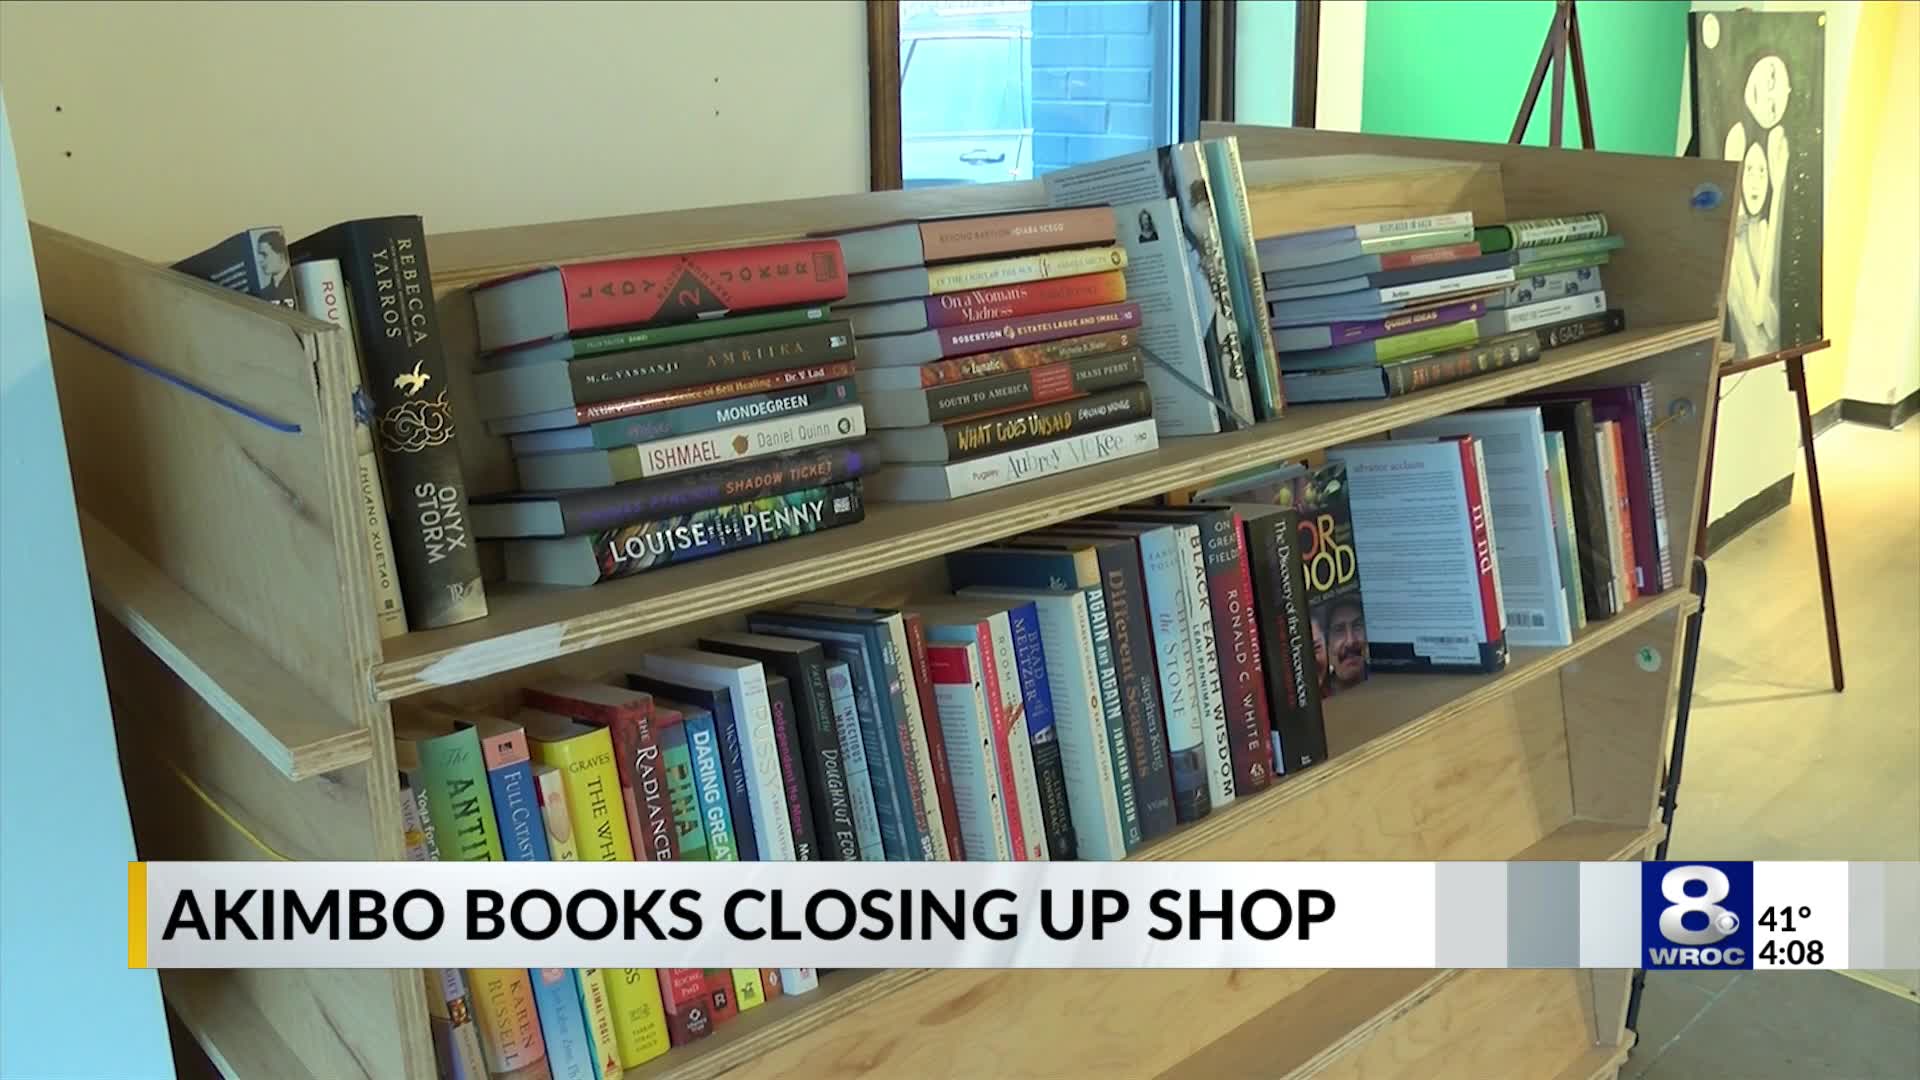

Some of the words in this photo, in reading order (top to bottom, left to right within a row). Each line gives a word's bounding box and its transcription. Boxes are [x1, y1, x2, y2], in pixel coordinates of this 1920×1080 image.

[373, 249, 401, 339] YARROS
[397, 238, 427, 344] REBECCA
[579, 279, 657, 300] LADY
[679, 287, 700, 306] 2
[720, 263, 809, 282] JOKER
[940, 294, 963, 310] On
[964, 296, 973, 307] a
[952, 330, 1004, 345] ROBERTSON
[1016, 323, 1053, 336] ESTATES
[1054, 319, 1079, 331] LARGE
[1080, 316, 1096, 326] AND
[1096, 313, 1120, 324] SMALL
[961, 305, 1014, 322] Madness
[1559, 323, 1585, 342] GAZA
[616, 361, 680, 379] VASSANJI
[807, 367, 824, 378] Lad
[716, 394, 809, 423] MONDEGREEN
[938, 395, 971, 409] SOUTH
[973, 392, 987, 402] TO
[988, 384, 1029, 400] AMERICA
[649, 440, 721, 472] ISHMAEL
[757, 431, 794, 449] Daniel
[800, 423, 831, 442] Quinn
[958, 423, 992, 450] WHAT
[996, 418, 1027, 442] GOES
[1027, 411, 1072, 435] UNSAID
[726, 471, 783, 495] SHADOW
[789, 461, 833, 481] TICKET
[414, 482, 447, 565] STORM
[438, 486, 467, 552] ONYX
[609, 523, 709, 562] LOUISE
[743, 500, 824, 536] PENNY
[1208, 533, 1236, 549] GREA
[1214, 519, 1230, 532] ON
[1275, 520, 1287, 541] The
[372, 531, 390, 589] XUETAO
[1208, 549, 1239, 564] FIELD
[1276, 544, 1293, 601] Discovery
[1086, 588, 1102, 643] AGAIN
[1159, 611, 1170, 634] the
[1284, 599, 1294, 616] of
[1287, 615, 1298, 636] the
[998, 636, 1012, 681] ROOM
[1014, 618, 1036, 701] MELTZER
[1028, 631, 1044, 679] BRAD
[1097, 644, 1107, 667] AND
[1108, 569, 1137, 682] Different
[1126, 684, 1149, 779] Seasons
[1190, 535, 1209, 610] BLACK
[1202, 617, 1221, 697] EARTH
[1213, 707, 1235, 798] WISDOM
[1193, 623, 1202, 653] LEAH
[1198, 656, 1211, 717] PENNIMAN
[1228, 589, 1247, 664] RONALD
[1240, 694, 1260, 750] WHITE
[1289, 636, 1308, 708] Unconscious
[1100, 667, 1122, 720] AGAIN
[1163, 641, 1185, 719] STONE
[637, 718, 650, 740] THE
[773, 702, 794, 783] Codependent
[835, 714, 851, 761] MADNESS
[844, 707, 862, 764] INFECTIOUS
[1139, 676, 1157, 727] Stephen
[1149, 731, 1163, 772] King
[569, 753, 611, 773] GRAVES
[693, 730, 720, 802] DARING
[752, 706, 781, 795] PUSSY
[1113, 727, 1131, 781] JONATHAN
[587, 776, 607, 818] THE
[636, 745, 671, 861] RADIANCE
[732, 770, 746, 797] TIME
[788, 784, 799, 800] No
[821, 748, 849, 828] DOUGHNUT
[1043, 770, 1060, 835] CONSPIRACY
[1123, 782, 1137, 824] EVISON
[416, 790, 431, 821] Yoga
[424, 826, 435, 845] for
[503, 771, 521, 807] FULL
[512, 808, 535, 861] CATAST
[790, 803, 804, 835] More
[488, 980, 519, 1067] RUSSELL
[510, 979, 535, 1049] KAREN
